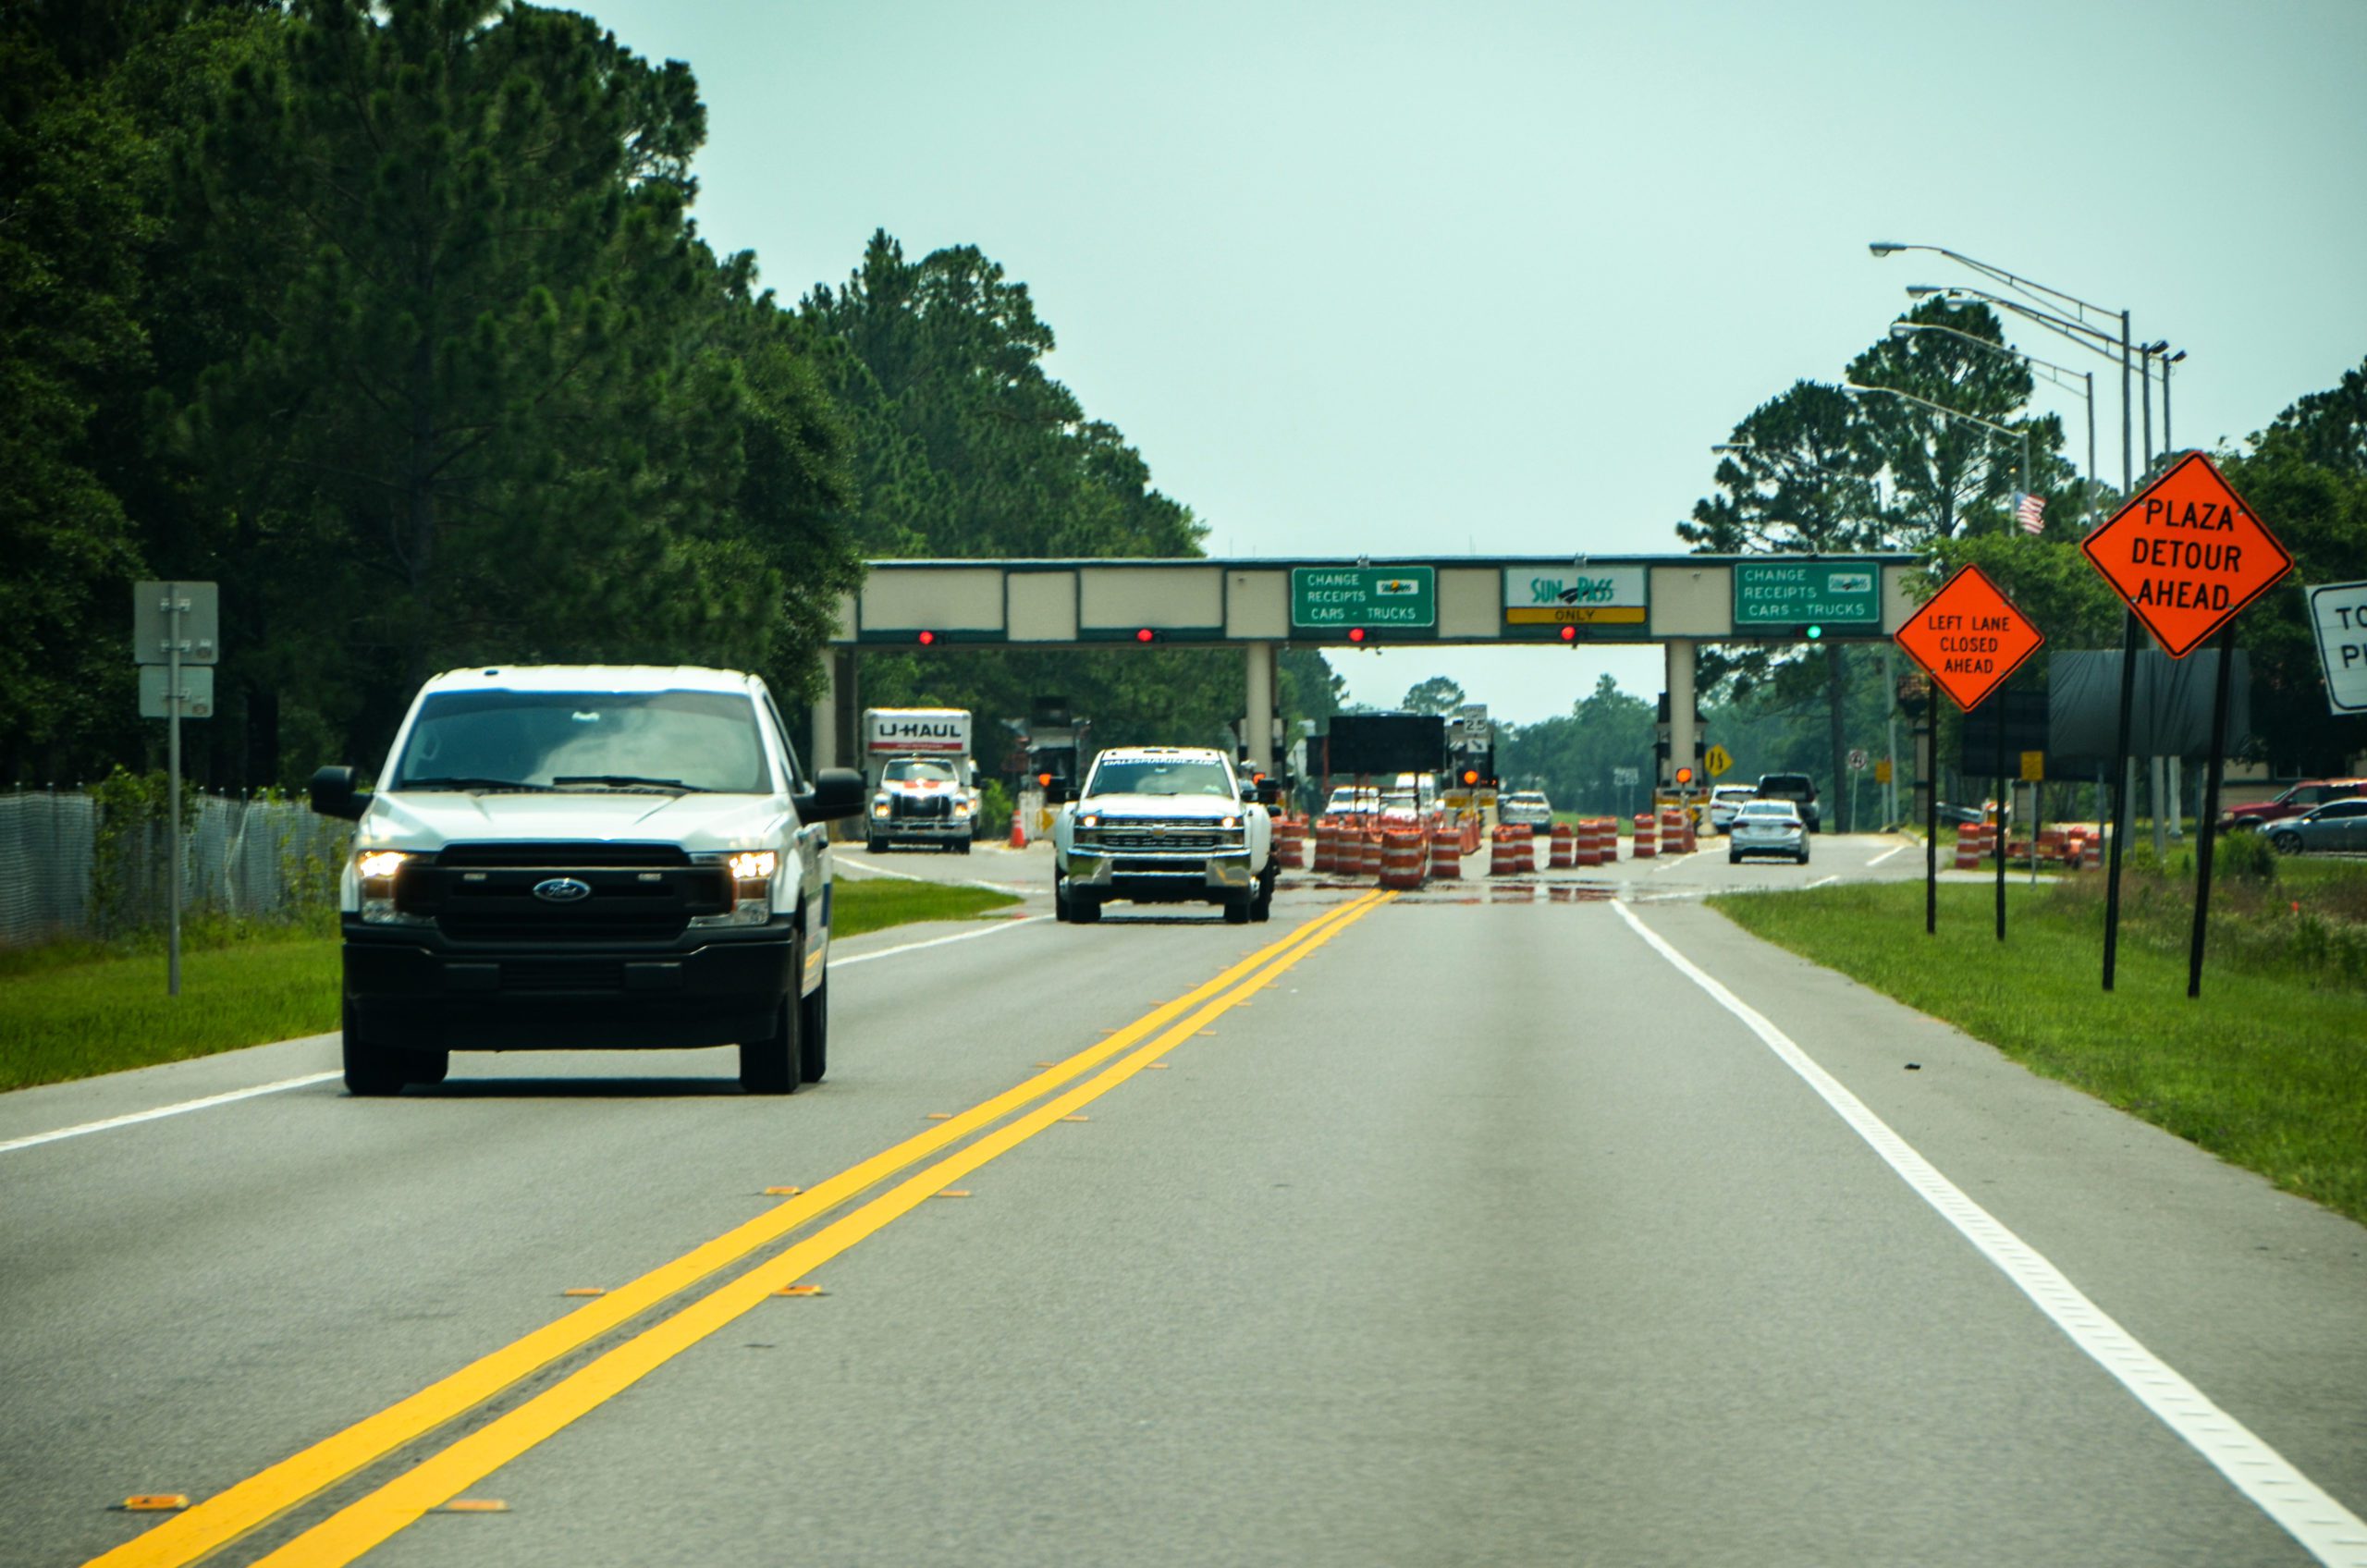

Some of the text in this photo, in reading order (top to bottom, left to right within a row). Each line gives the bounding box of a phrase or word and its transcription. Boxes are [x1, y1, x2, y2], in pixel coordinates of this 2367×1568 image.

[2145, 498, 2234, 532] PLAZA
[2131, 537, 2242, 573] DETOUR
[1307, 573, 1360, 586] CHANGE
[1745, 569, 1807, 582] CHANGE
[1306, 591, 1367, 603] RECEIPTS
[1744, 586, 1818, 599] RECEIPTS
[2136, 578, 2230, 611] AHEAD
[1311, 607, 1345, 620] CARS
[1367, 606, 1417, 620] TRUCKS
[1554, 609, 1596, 621] ONLY
[1748, 604, 1790, 617] CARS
[1806, 603, 1865, 617] TRUCKS
[1928, 615, 2011, 632] LEFT LANE
[1939, 637, 1998, 654] CLOSED
[1944, 658, 1993, 674] AHEAD
[879, 723, 962, 737] U-HAUL
[1466, 719, 1487, 730] 25
